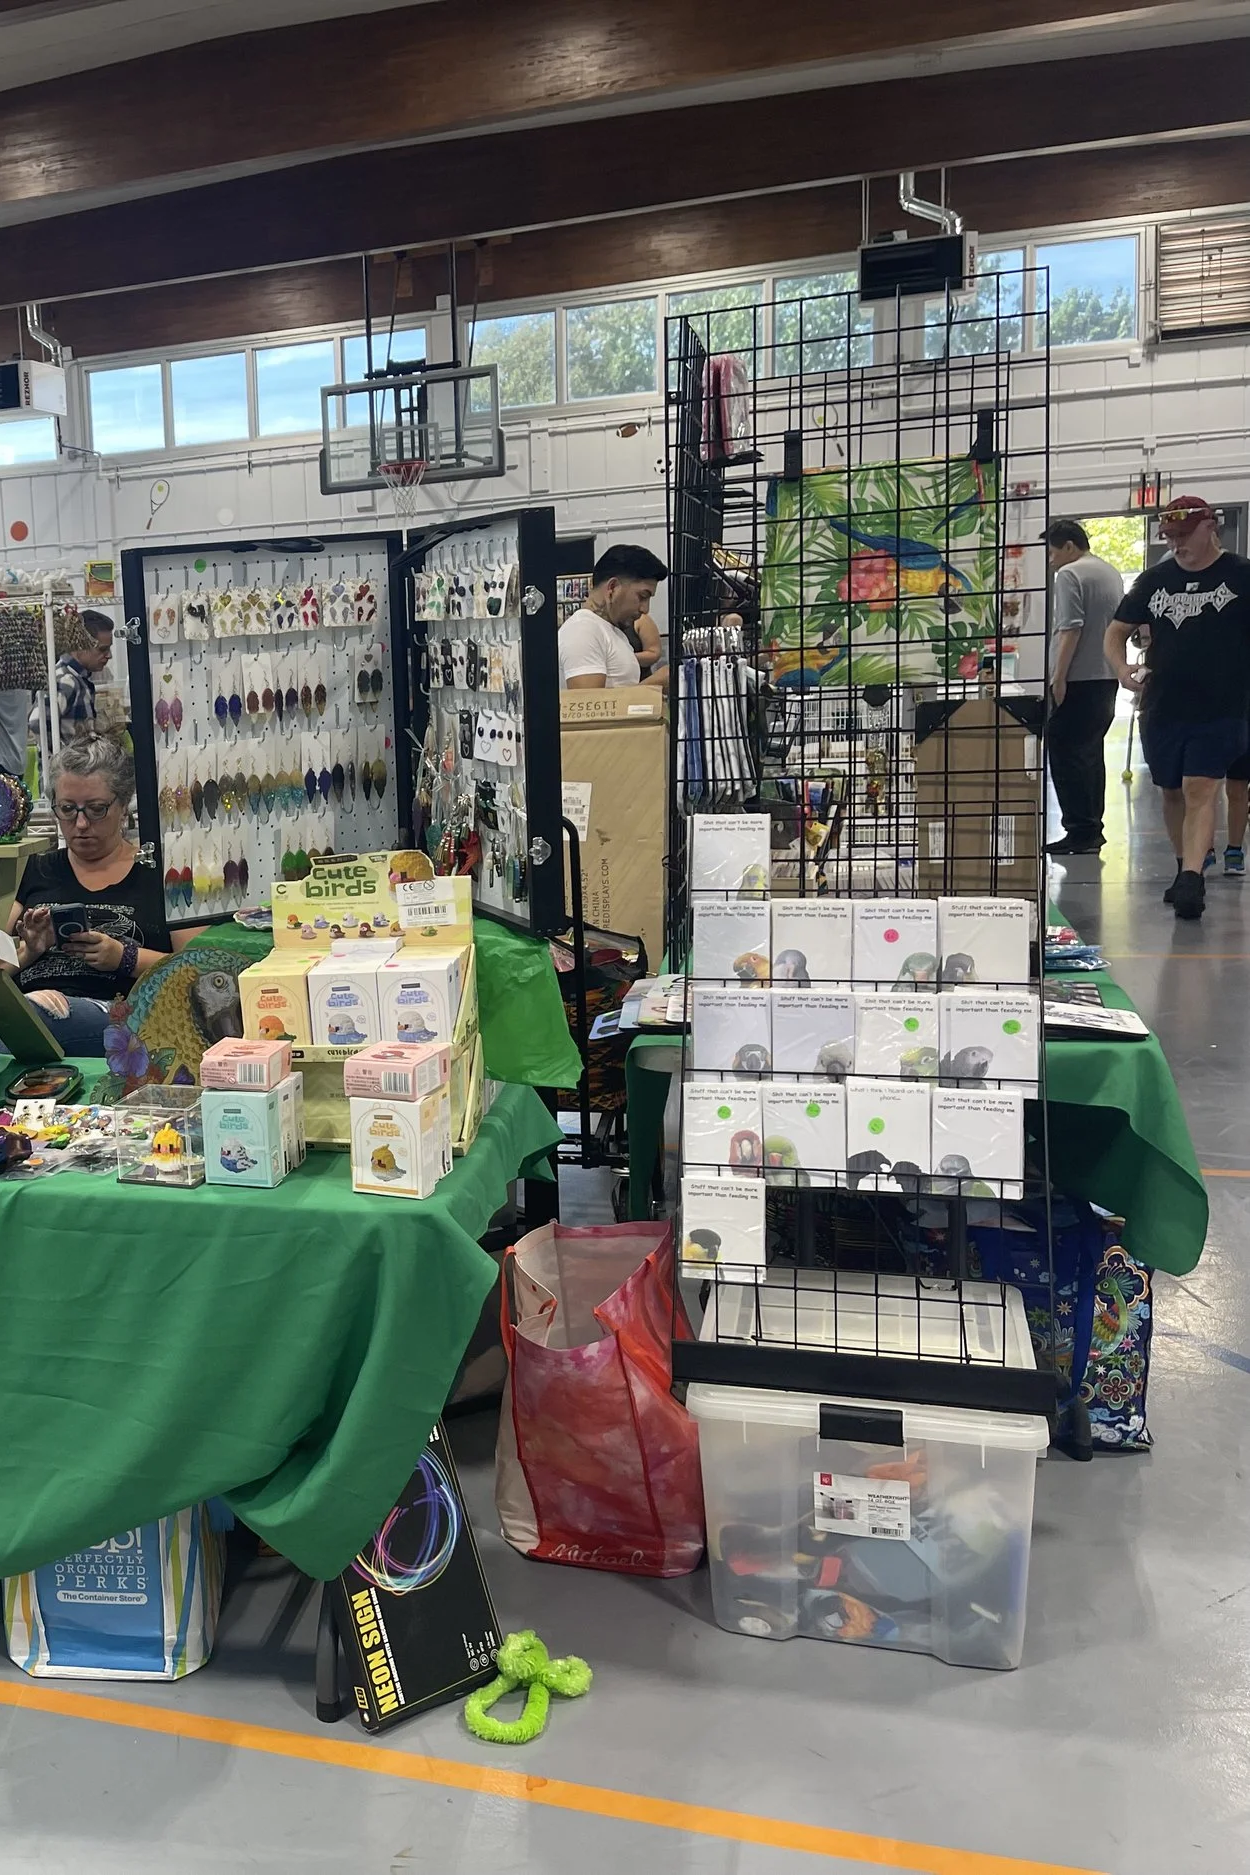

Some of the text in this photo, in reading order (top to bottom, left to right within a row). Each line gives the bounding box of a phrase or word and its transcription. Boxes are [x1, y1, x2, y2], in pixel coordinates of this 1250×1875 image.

[306, 880, 376, 898] birds
[601, 858, 610, 928] REDISPLAYS.COM
[592, 891, 600, 918] CHINA
[64, 1554, 144, 1564] ERFECTLY
[54, 1564, 146, 1575] ORGANIZED
[56, 1575, 146, 1590] PERKS
[62, 1592, 77, 1600] The
[78, 1593, 118, 1602] Container
[352, 1590, 399, 1714] NEON SIGN
